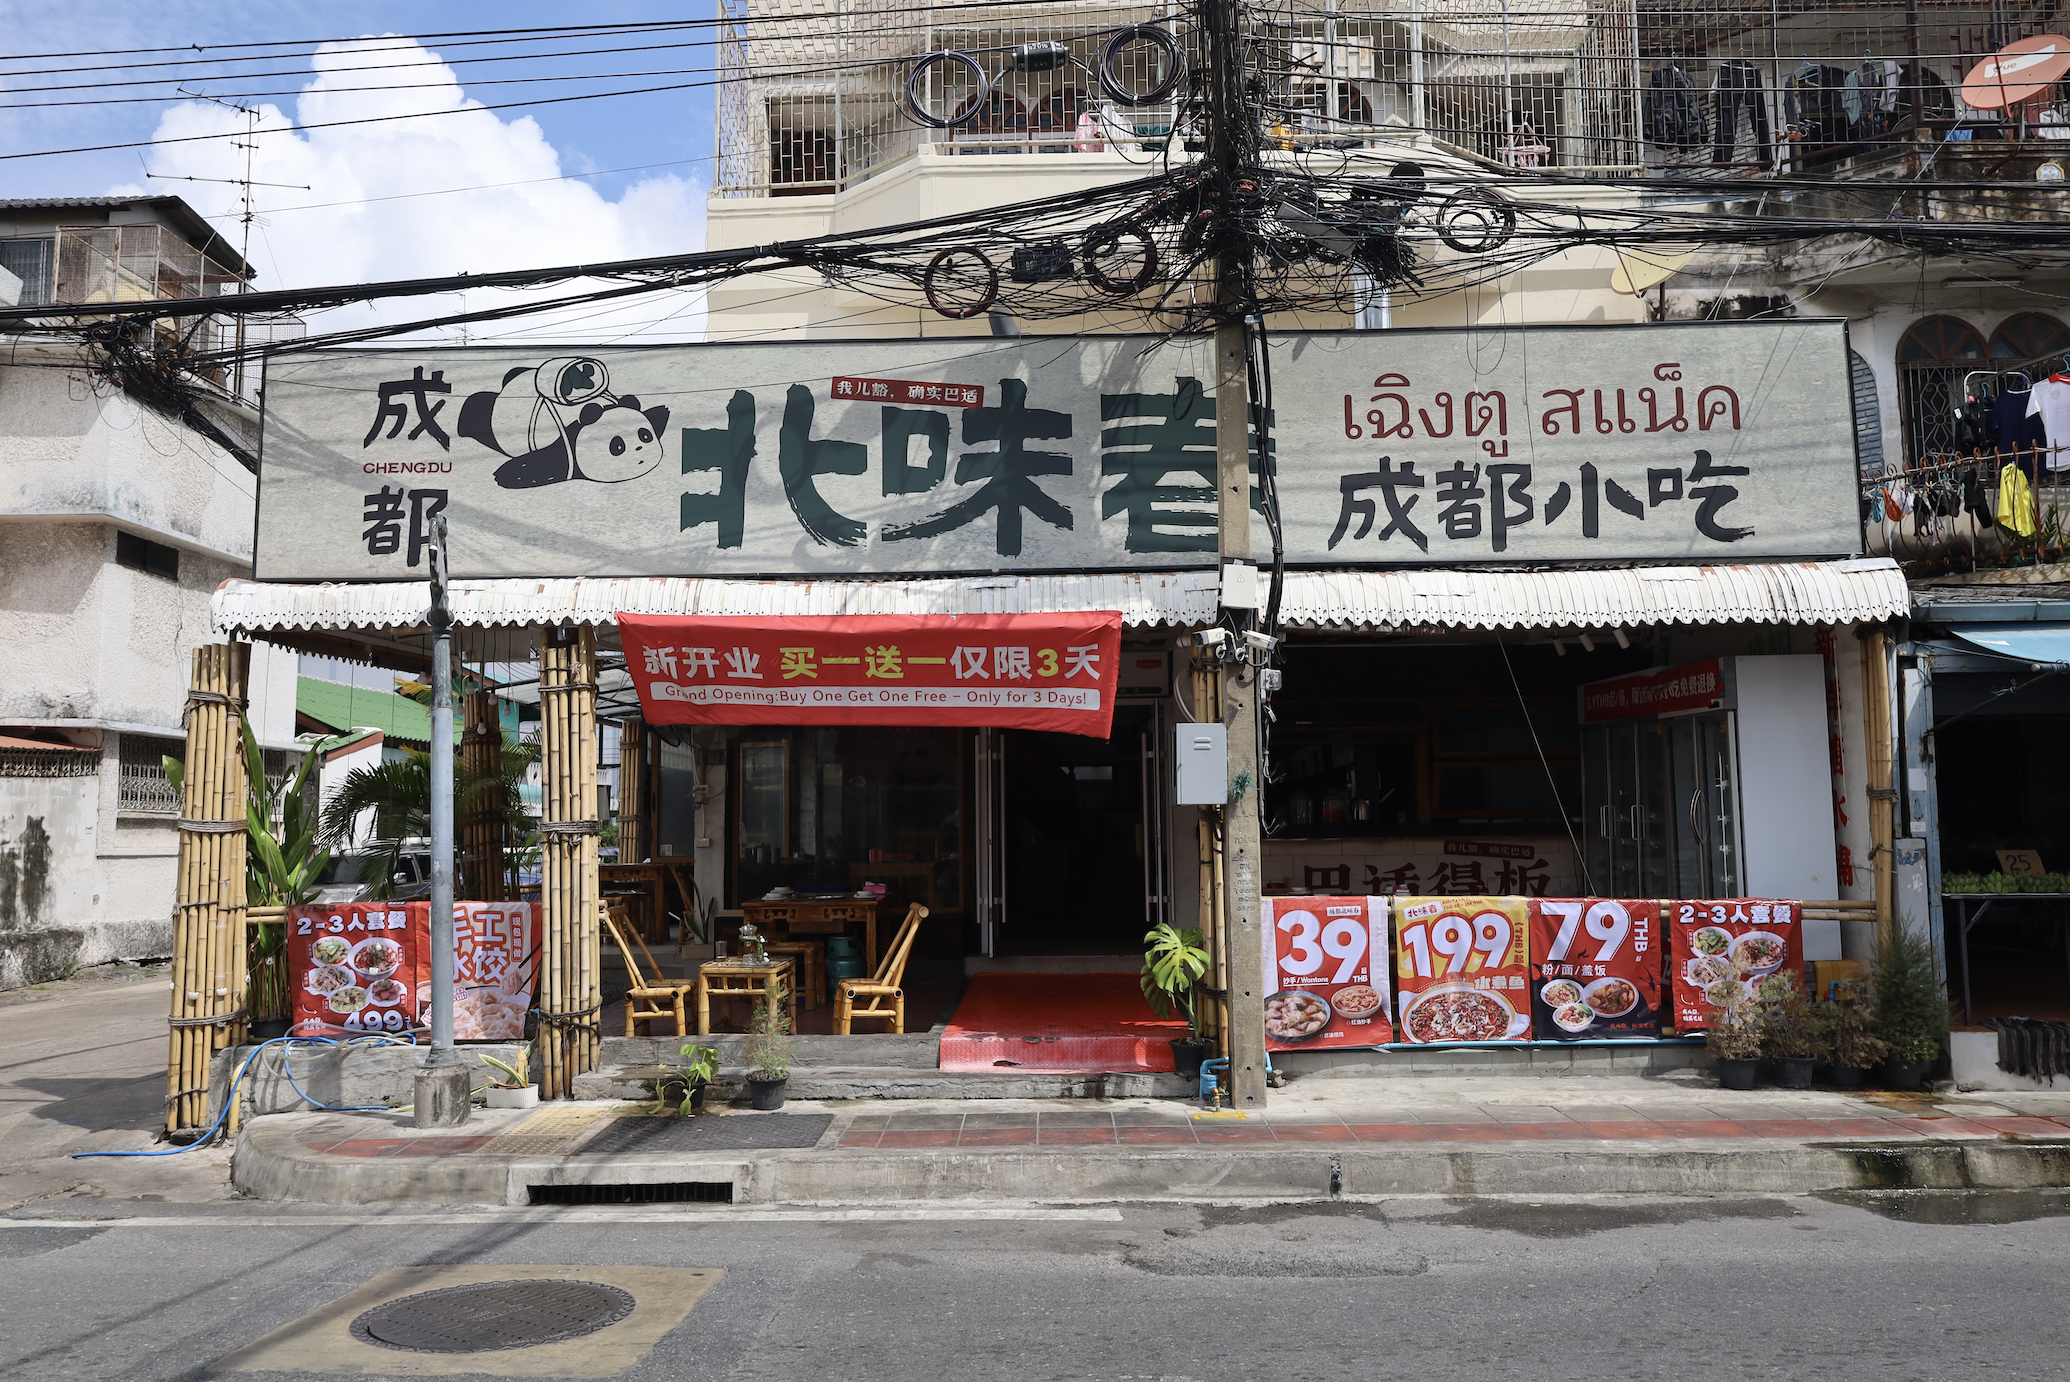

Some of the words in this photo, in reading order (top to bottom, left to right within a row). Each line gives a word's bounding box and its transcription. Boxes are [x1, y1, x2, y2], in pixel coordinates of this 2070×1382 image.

[1343, 373, 1508, 457] เฉิงตู
[1541, 363, 1742, 434] สแน็ค
[363, 462, 453, 474] CHENGDU
[1328, 450, 1756, 555] 成都小吃
[641, 646, 764, 681] 新开业
[664, 684, 707, 701] Grand
[812, 690, 844, 703] One
[847, 690, 874, 703] Get
[878, 690, 910, 704] One
[914, 690, 948, 703] Free
[967, 690, 1002, 707] Only
[1006, 691, 1029, 704] for
[1033, 691, 1042, 704] 3
[1047, 691, 1087, 708] Days!
[2005, 854, 2032, 872] 25
[296, 910, 407, 936] 2-3人套餐
[1408, 904, 1438, 918] 北味春
[1678, 904, 1792, 925] 2-3人套餐
[511, 916, 522, 957] 现包现做
[1402, 911, 1512, 978] 199
[1540, 902, 1632, 962] 79
[1277, 910, 1368, 984] 39
[1352, 975, 1368, 983] THB
[343, 1010, 404, 1032] 499
